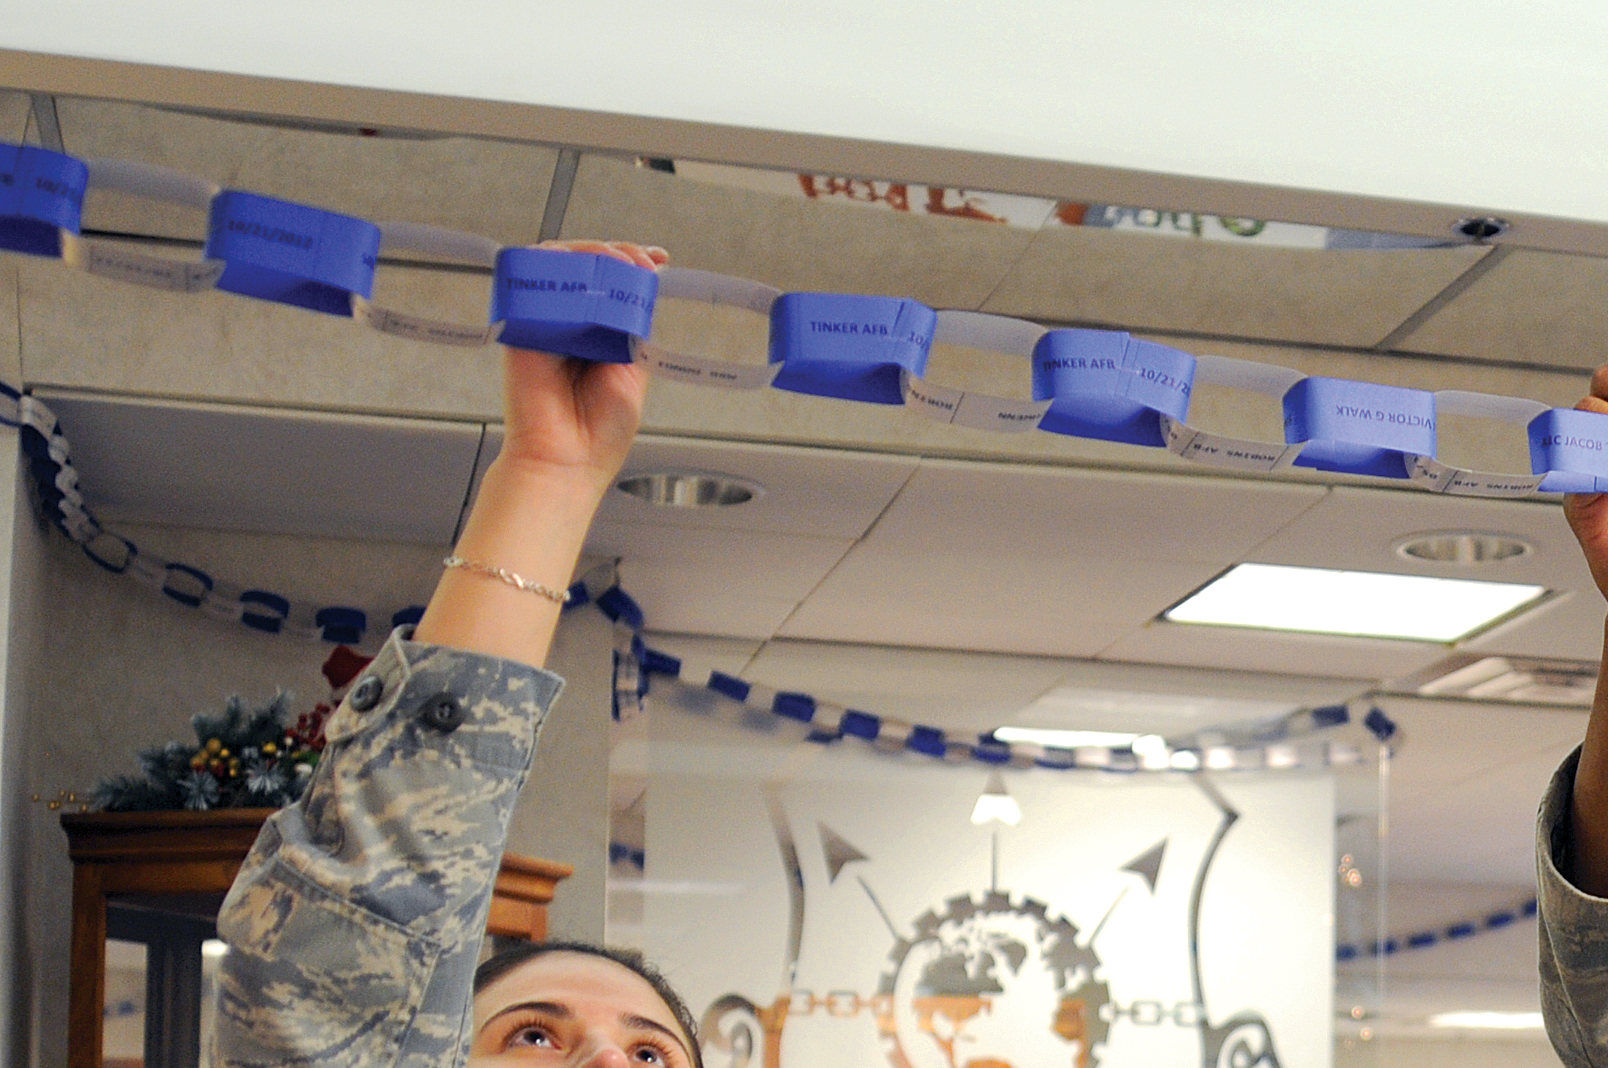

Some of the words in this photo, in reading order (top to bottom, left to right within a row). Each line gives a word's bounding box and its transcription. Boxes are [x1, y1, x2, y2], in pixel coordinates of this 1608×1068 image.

[507, 278, 556, 292] TINKER
[810, 320, 858, 334] TINKER
[862, 323, 888, 335] AFB
[1043, 357, 1088, 373] TINKER
[1090, 357, 1115, 370] AFB
[1335, 404, 1373, 420] WALK
[1375, 410, 1385, 421] G
[1388, 412, 1432, 430] VICTOR
[1564, 435, 1603, 451] JACOB
